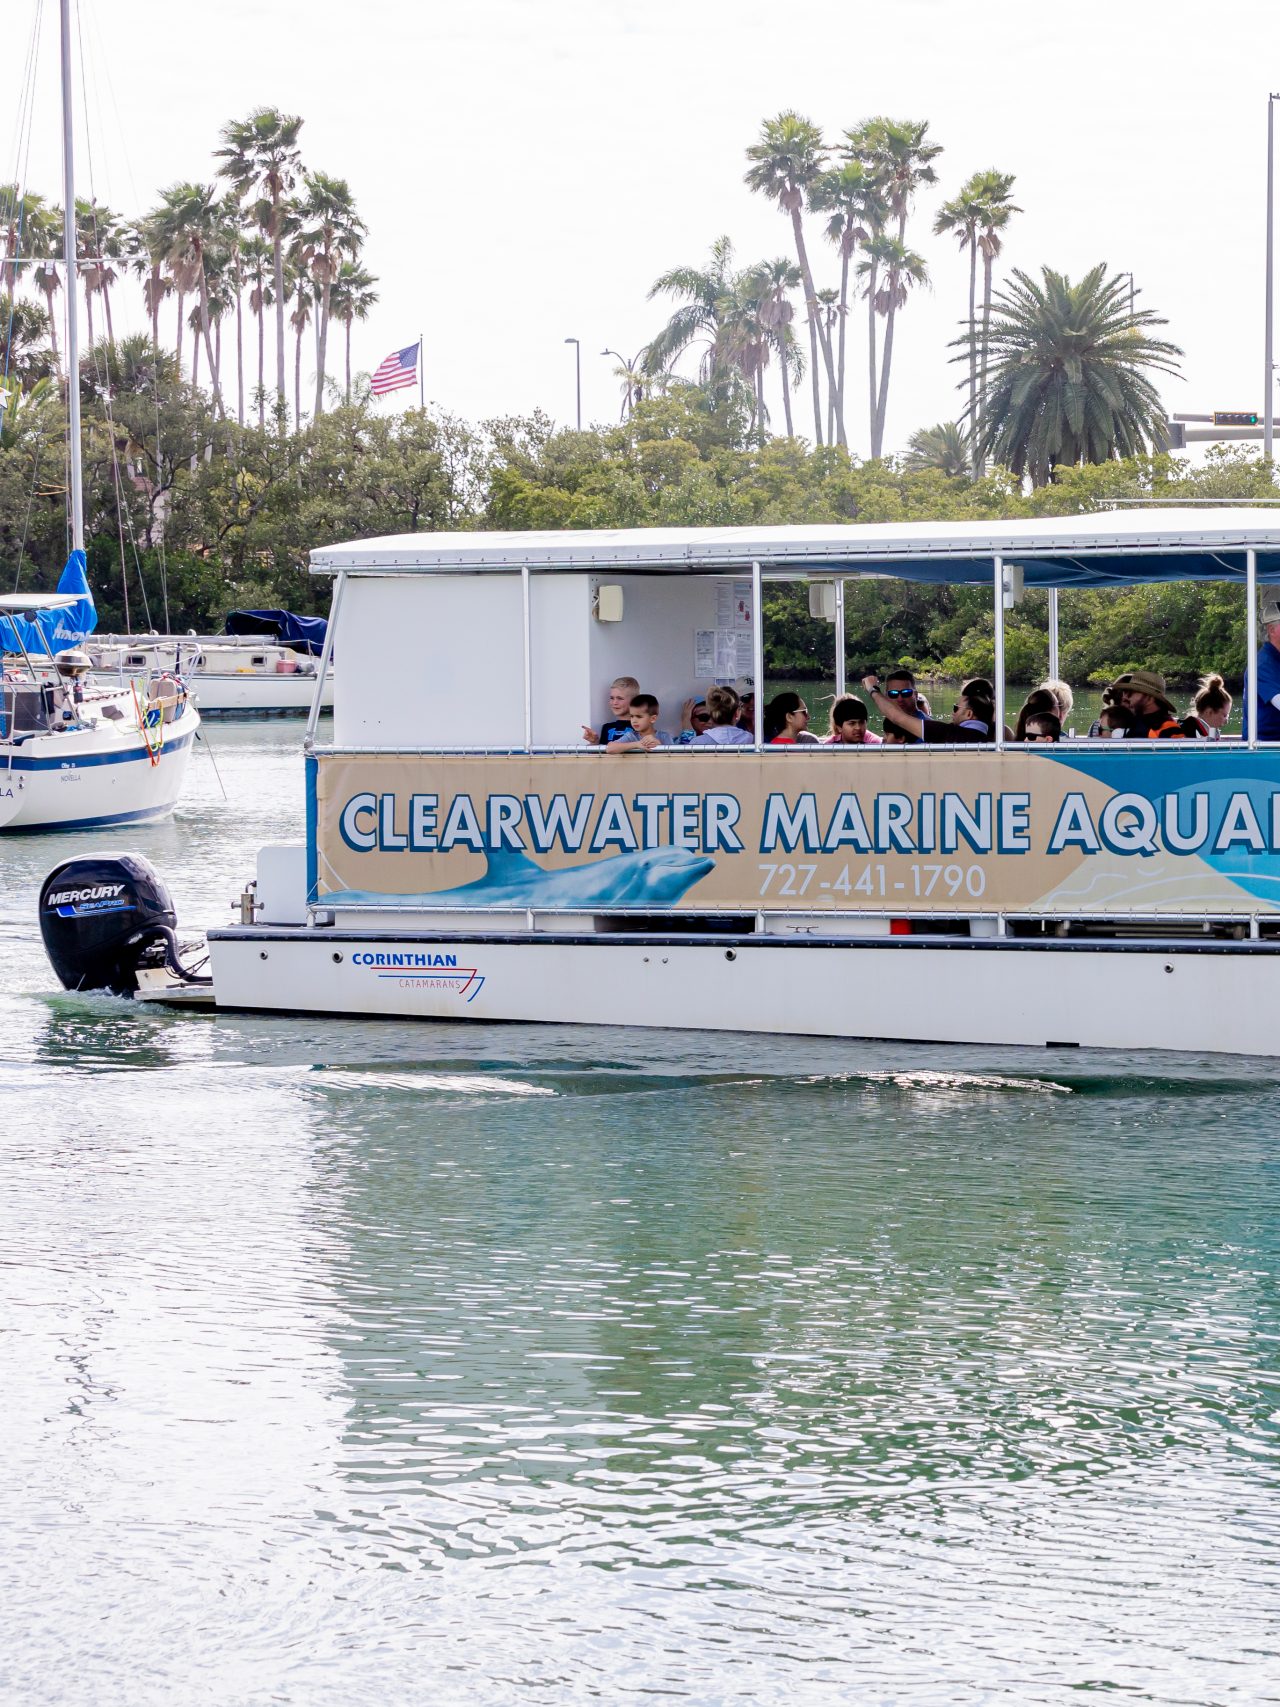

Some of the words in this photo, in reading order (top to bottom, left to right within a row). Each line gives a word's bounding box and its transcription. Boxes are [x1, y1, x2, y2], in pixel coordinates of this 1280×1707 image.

[339, 792, 746, 854] CLEARWATER
[759, 792, 1031, 855] MARINE
[758, 863, 986, 897] 727-441-1790
[48, 884, 126, 906] MERCURY
[352, 953, 457, 967] CORINTHIAN
[399, 979, 461, 989] CATAMARANS
